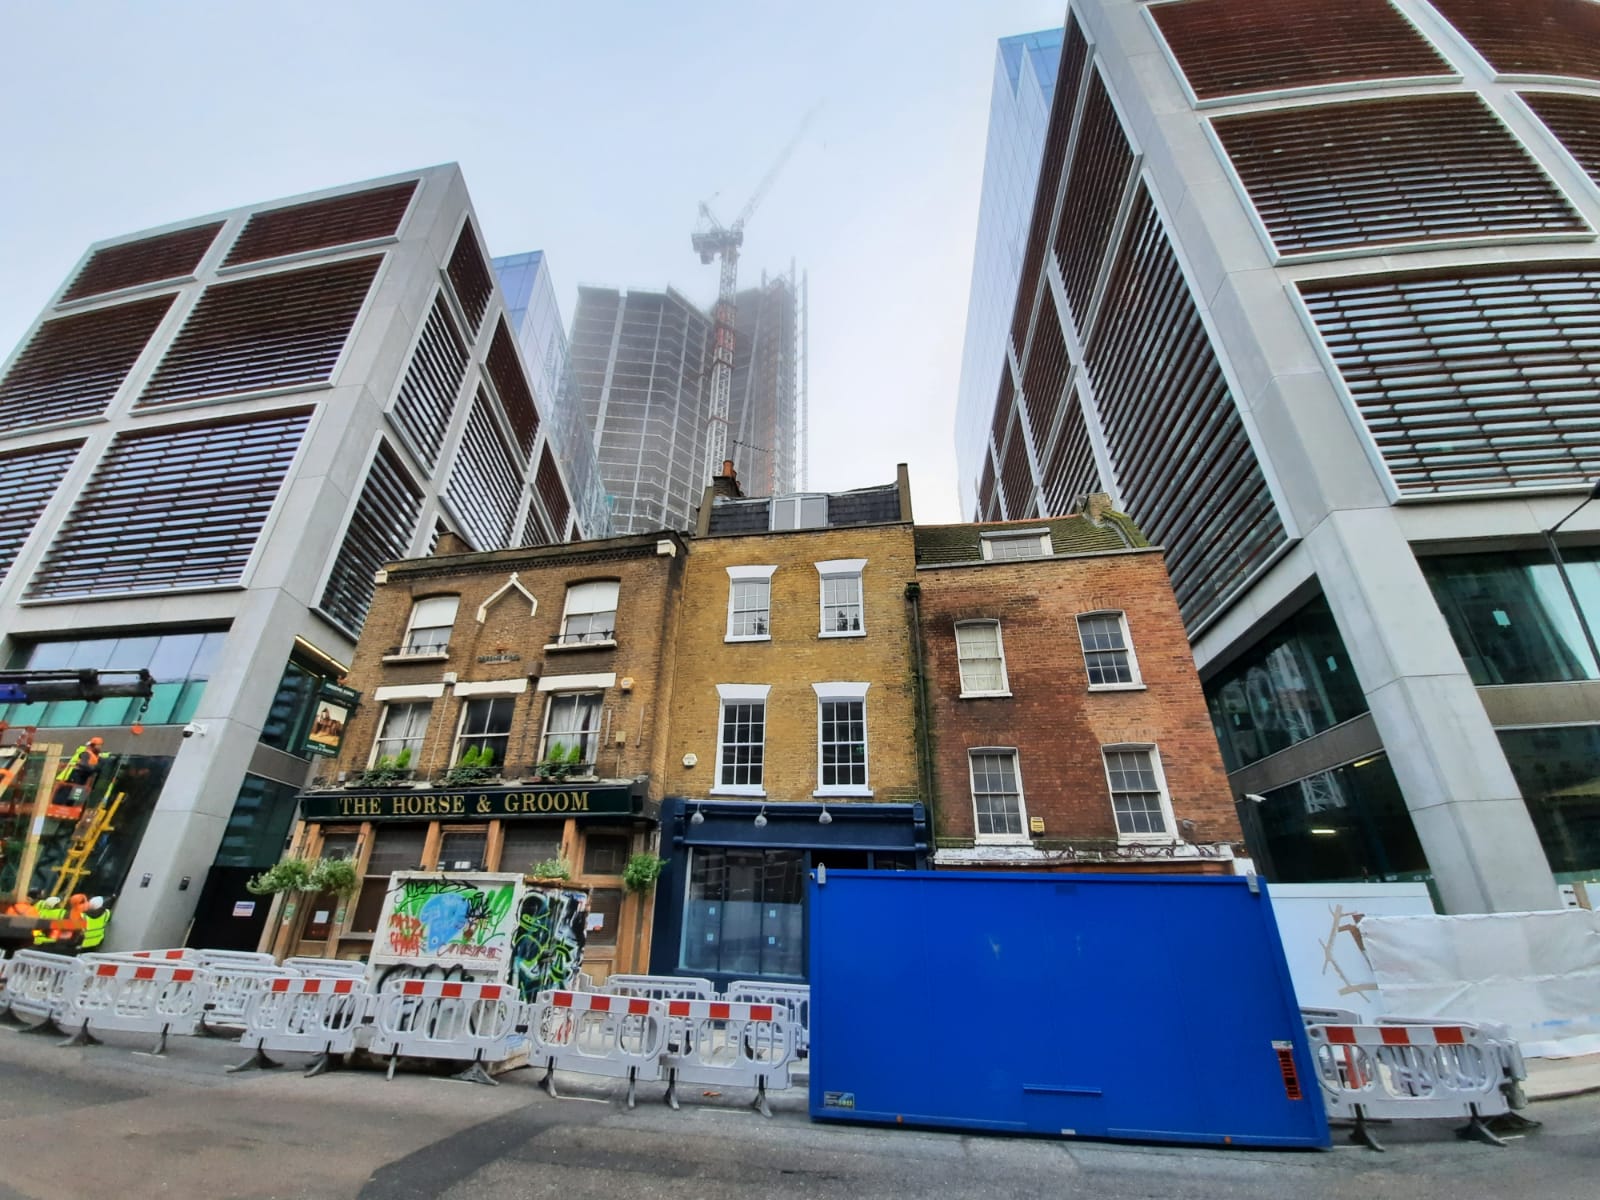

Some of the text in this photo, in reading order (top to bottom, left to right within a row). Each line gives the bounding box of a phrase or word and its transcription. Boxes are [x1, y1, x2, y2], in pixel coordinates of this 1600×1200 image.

[340, 791, 590, 815] THE HORSE & GROOM
